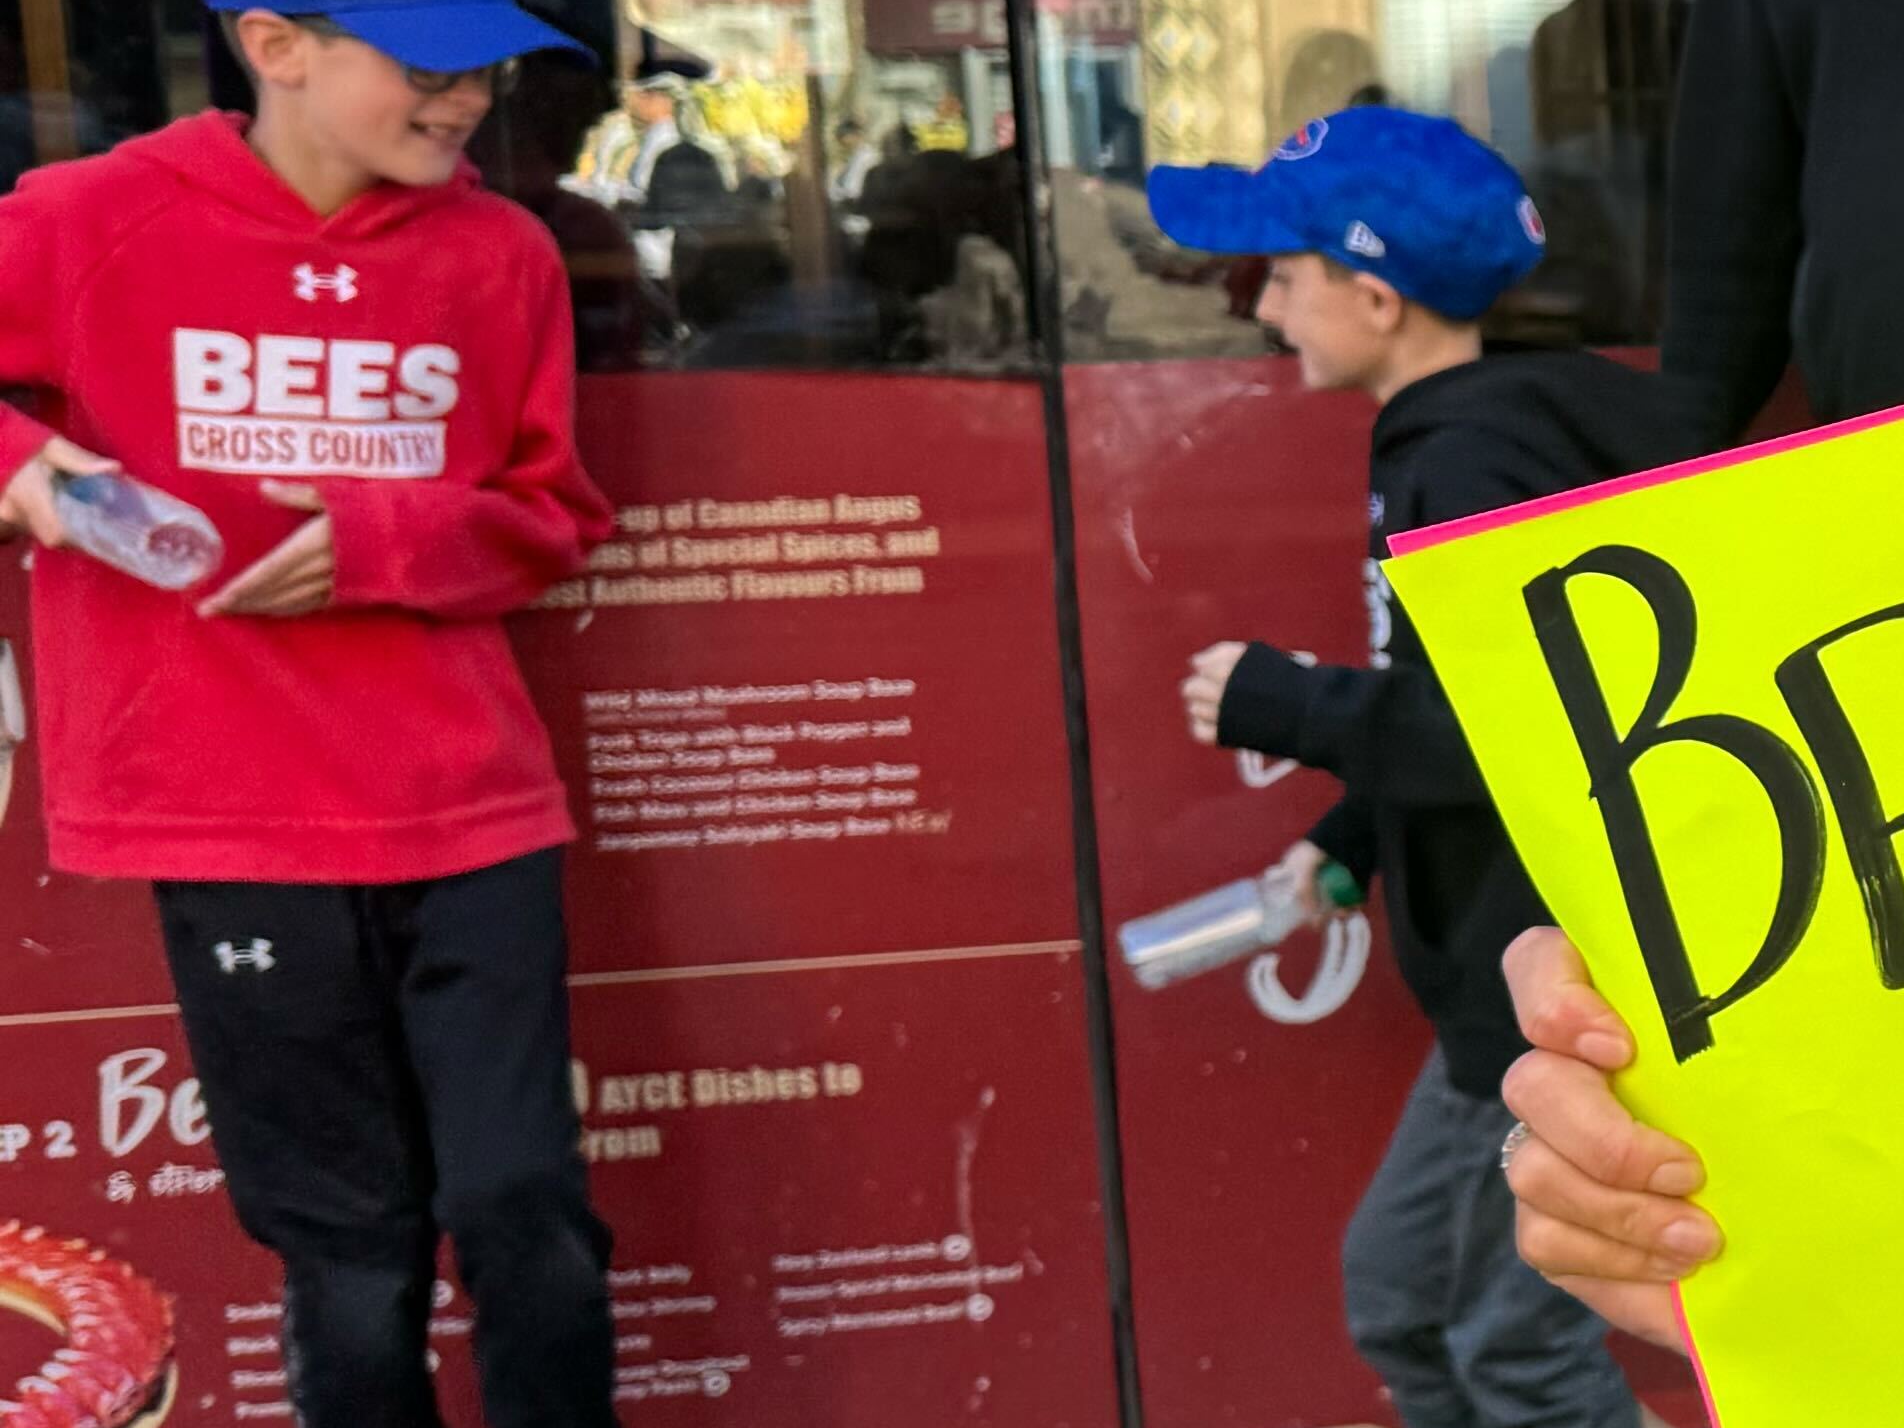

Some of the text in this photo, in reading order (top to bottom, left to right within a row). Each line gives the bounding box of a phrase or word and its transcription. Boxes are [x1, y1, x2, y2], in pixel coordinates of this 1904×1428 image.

[174, 327, 461, 419] BEES
[187, 423, 437, 469] CROSS COUNTRY
[600, 1074, 687, 1116] AYCE
[690, 1065, 819, 1109] Dishes
[823, 1060, 863, 1099] to
[43, 1119, 78, 1159] 2
